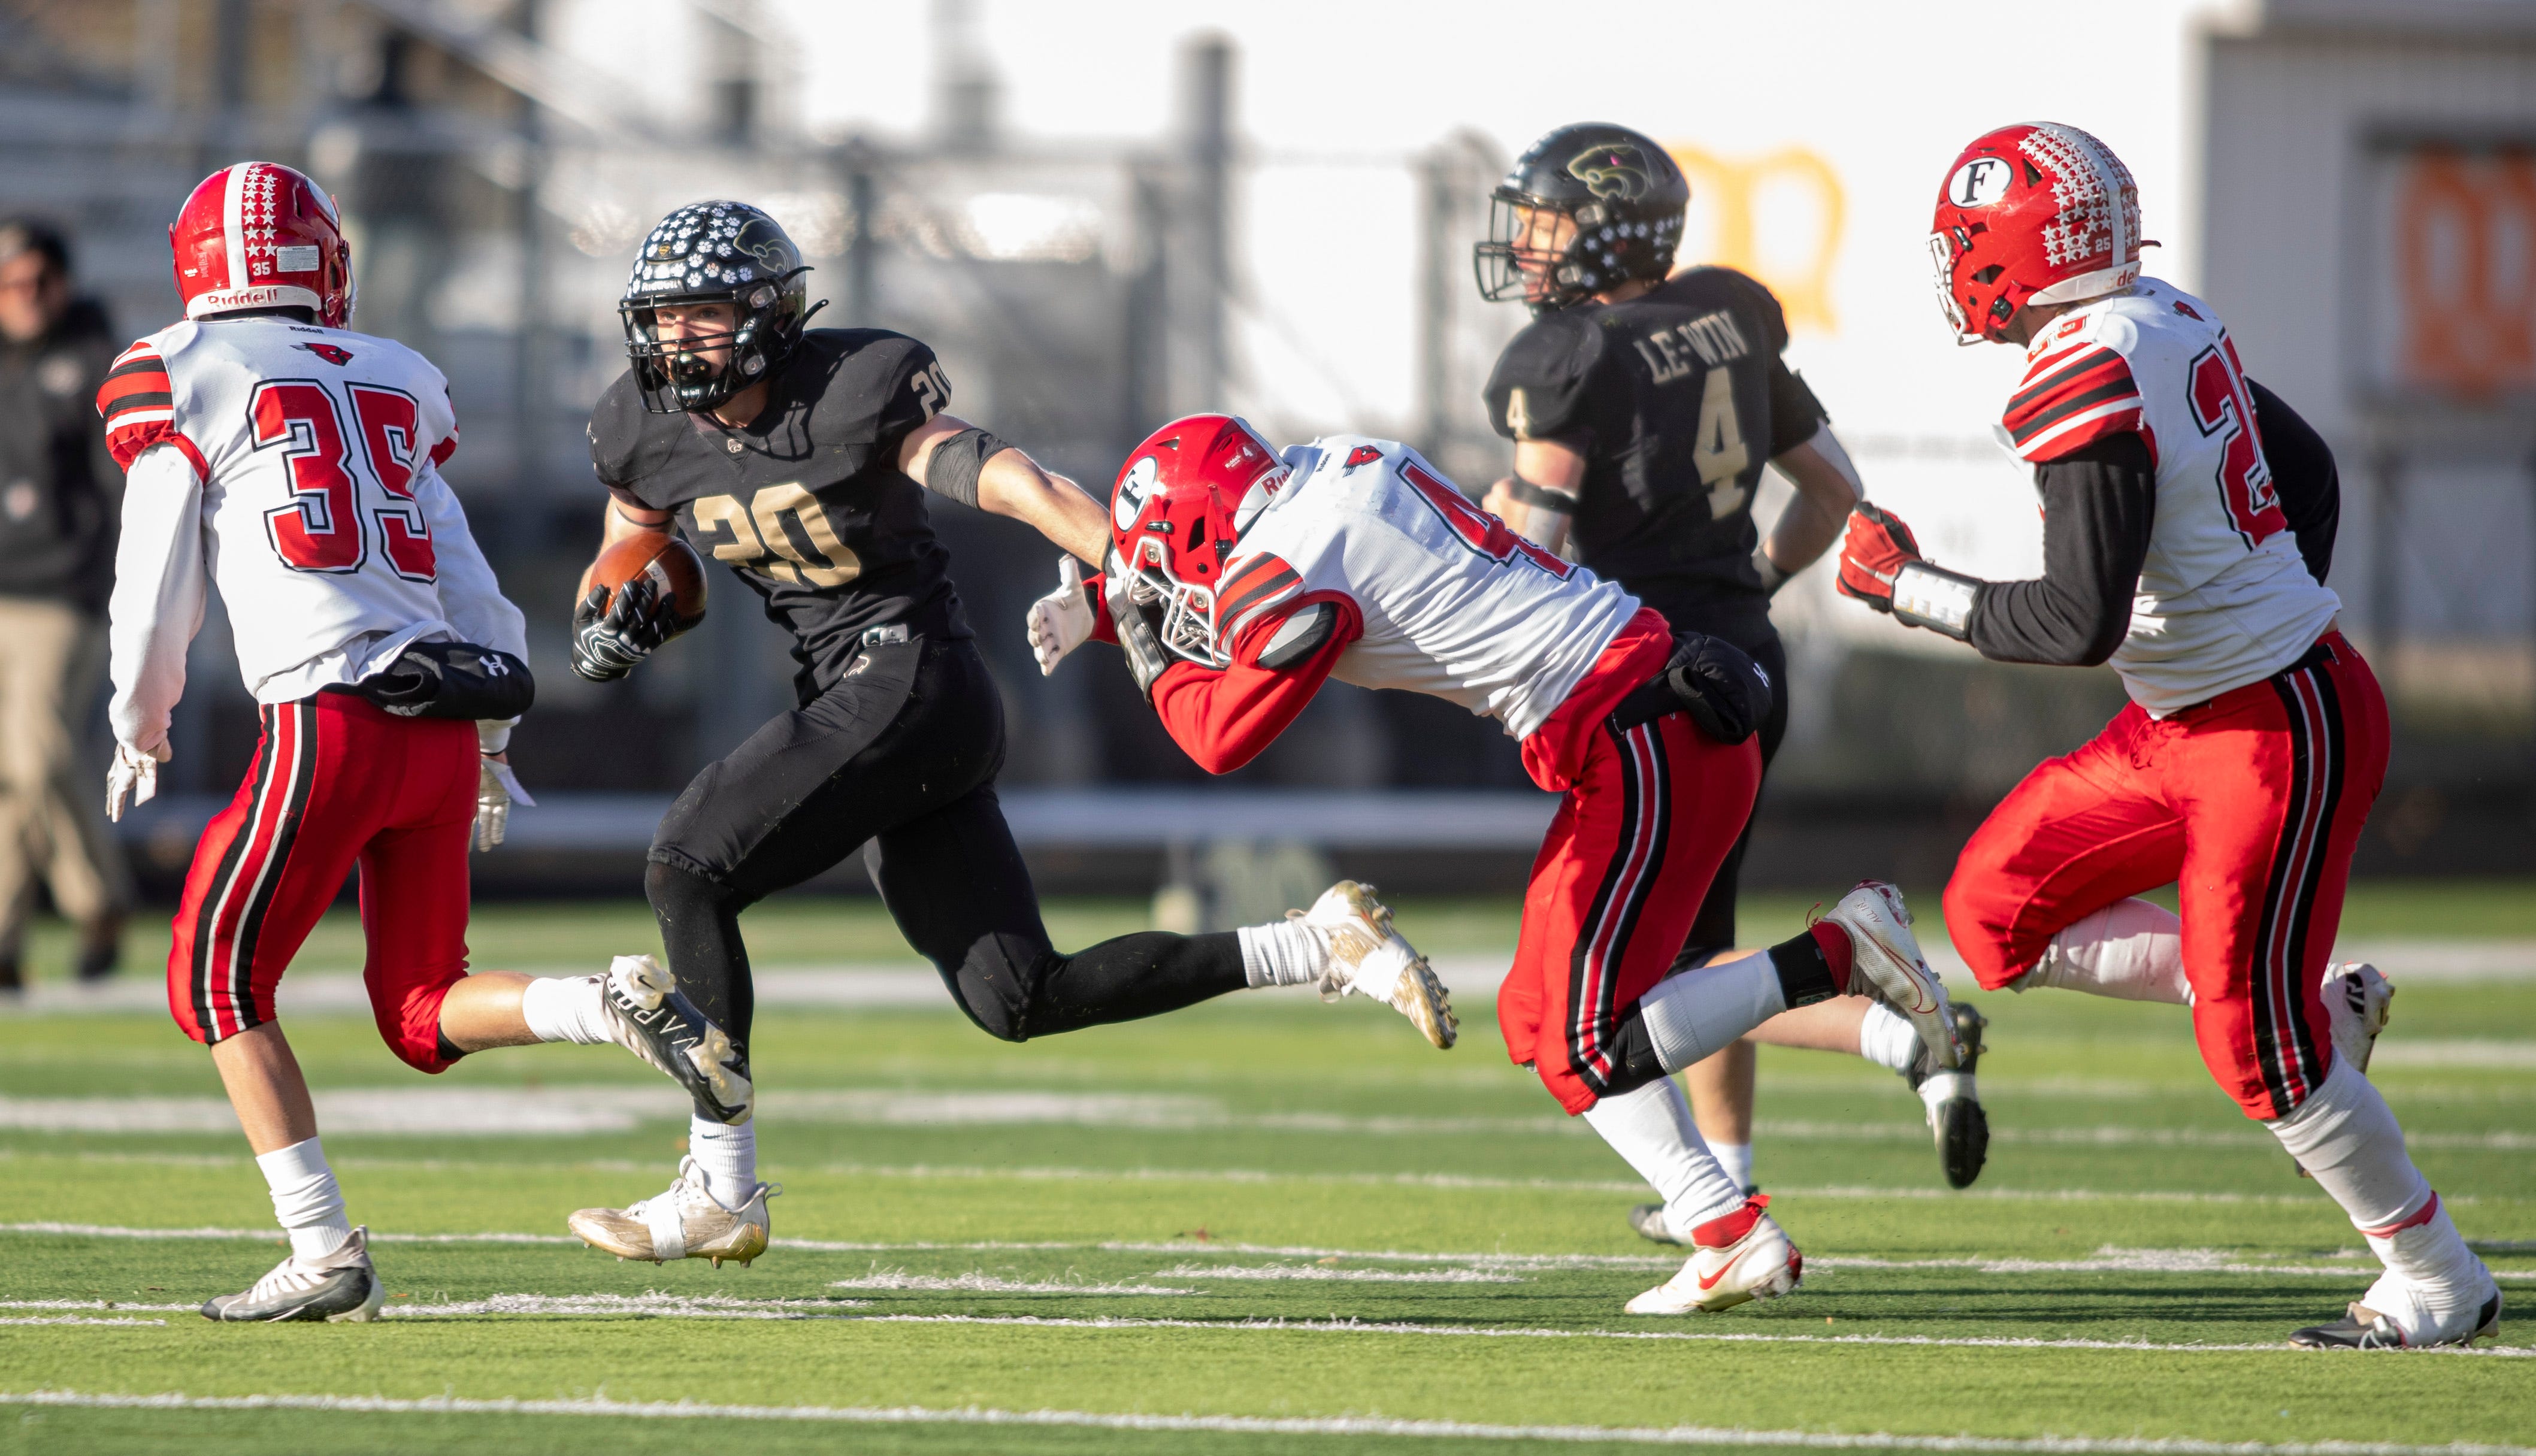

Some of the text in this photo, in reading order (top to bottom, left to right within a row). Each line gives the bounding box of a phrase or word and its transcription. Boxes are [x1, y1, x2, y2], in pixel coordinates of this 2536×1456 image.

[1962, 161, 1995, 204] F
[253, 262, 271, 276] 35
[2095, 237, 2111, 252] 25
[208, 289, 278, 306] Riddell
[1633, 310, 1748, 385] LE-WIN
[910, 361, 952, 423] 20
[1506, 388, 1528, 441] 4
[1242, 446, 1254, 457] 4
[1692, 366, 1748, 520] 4
[246, 377, 437, 586] 35
[1118, 469, 1144, 516] F
[693, 482, 861, 586] 20
[1395, 456, 1578, 582] 4
